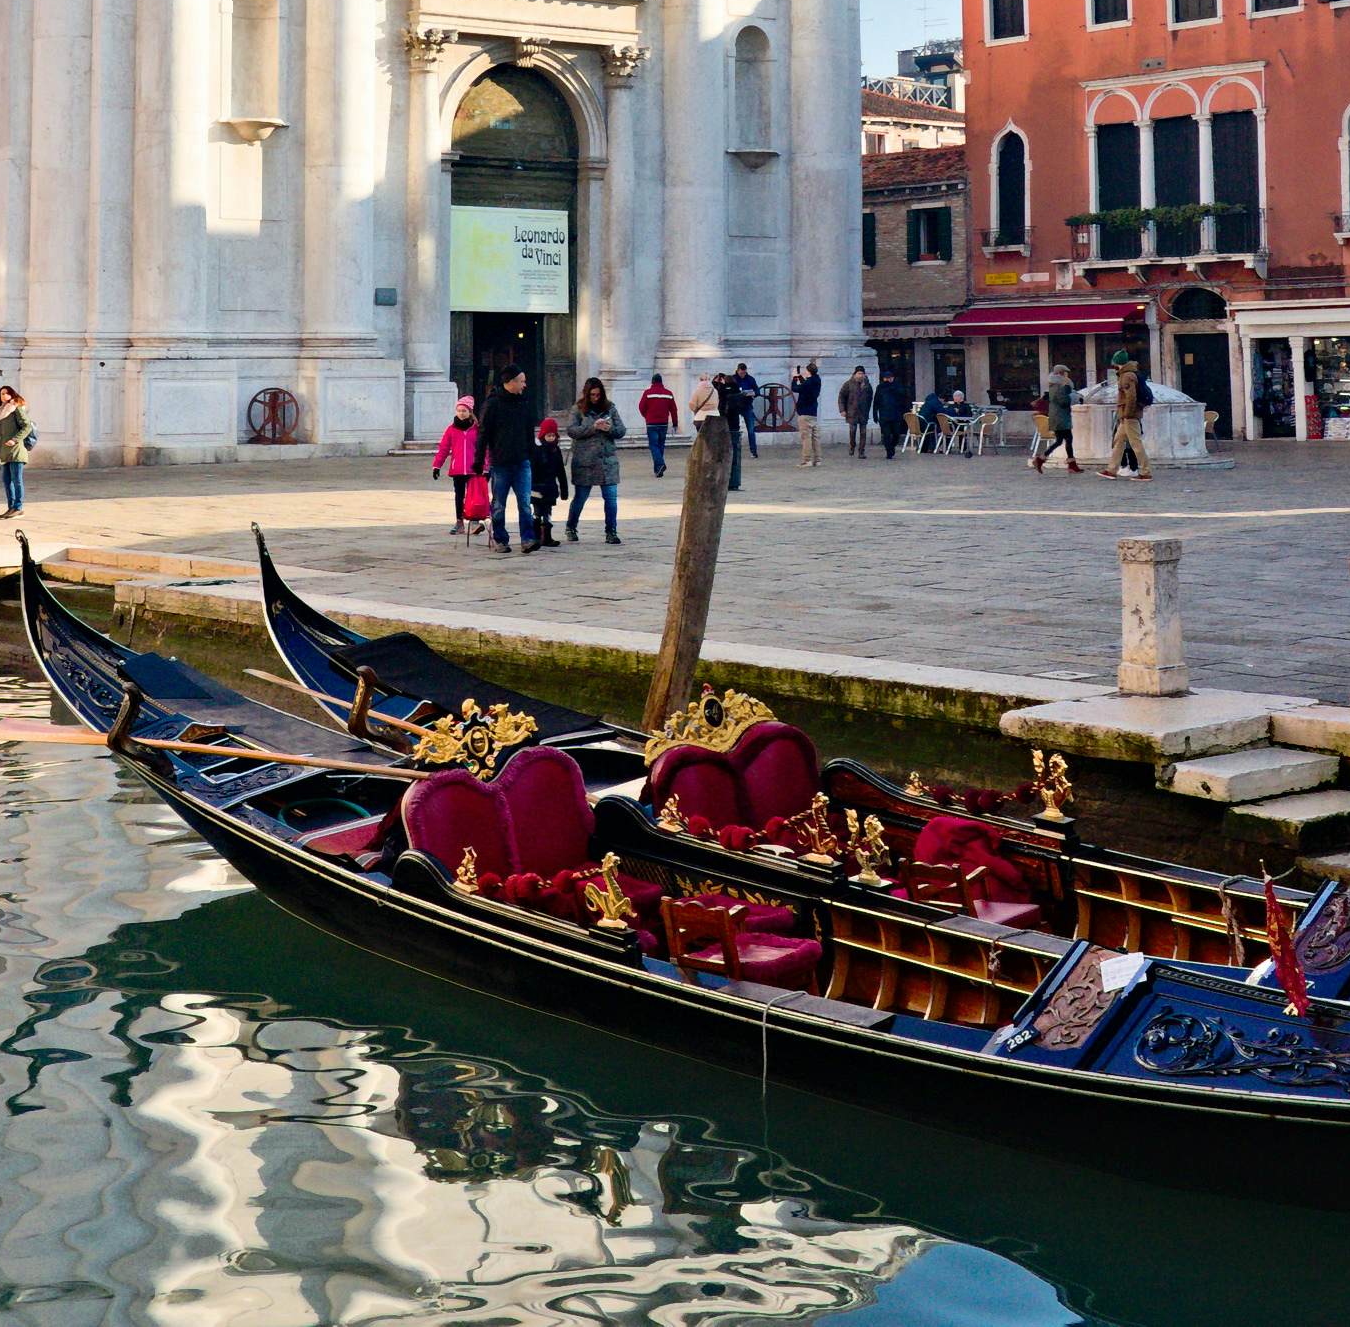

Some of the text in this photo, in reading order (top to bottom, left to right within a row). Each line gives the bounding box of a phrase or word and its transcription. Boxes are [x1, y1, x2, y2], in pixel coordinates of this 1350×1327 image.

[514, 225, 566, 244] Leonardo
[521, 244, 562, 265] da Vinci
[866, 327, 953, 338] IZZO PANE
[1007, 1030, 1032, 1049] 282
